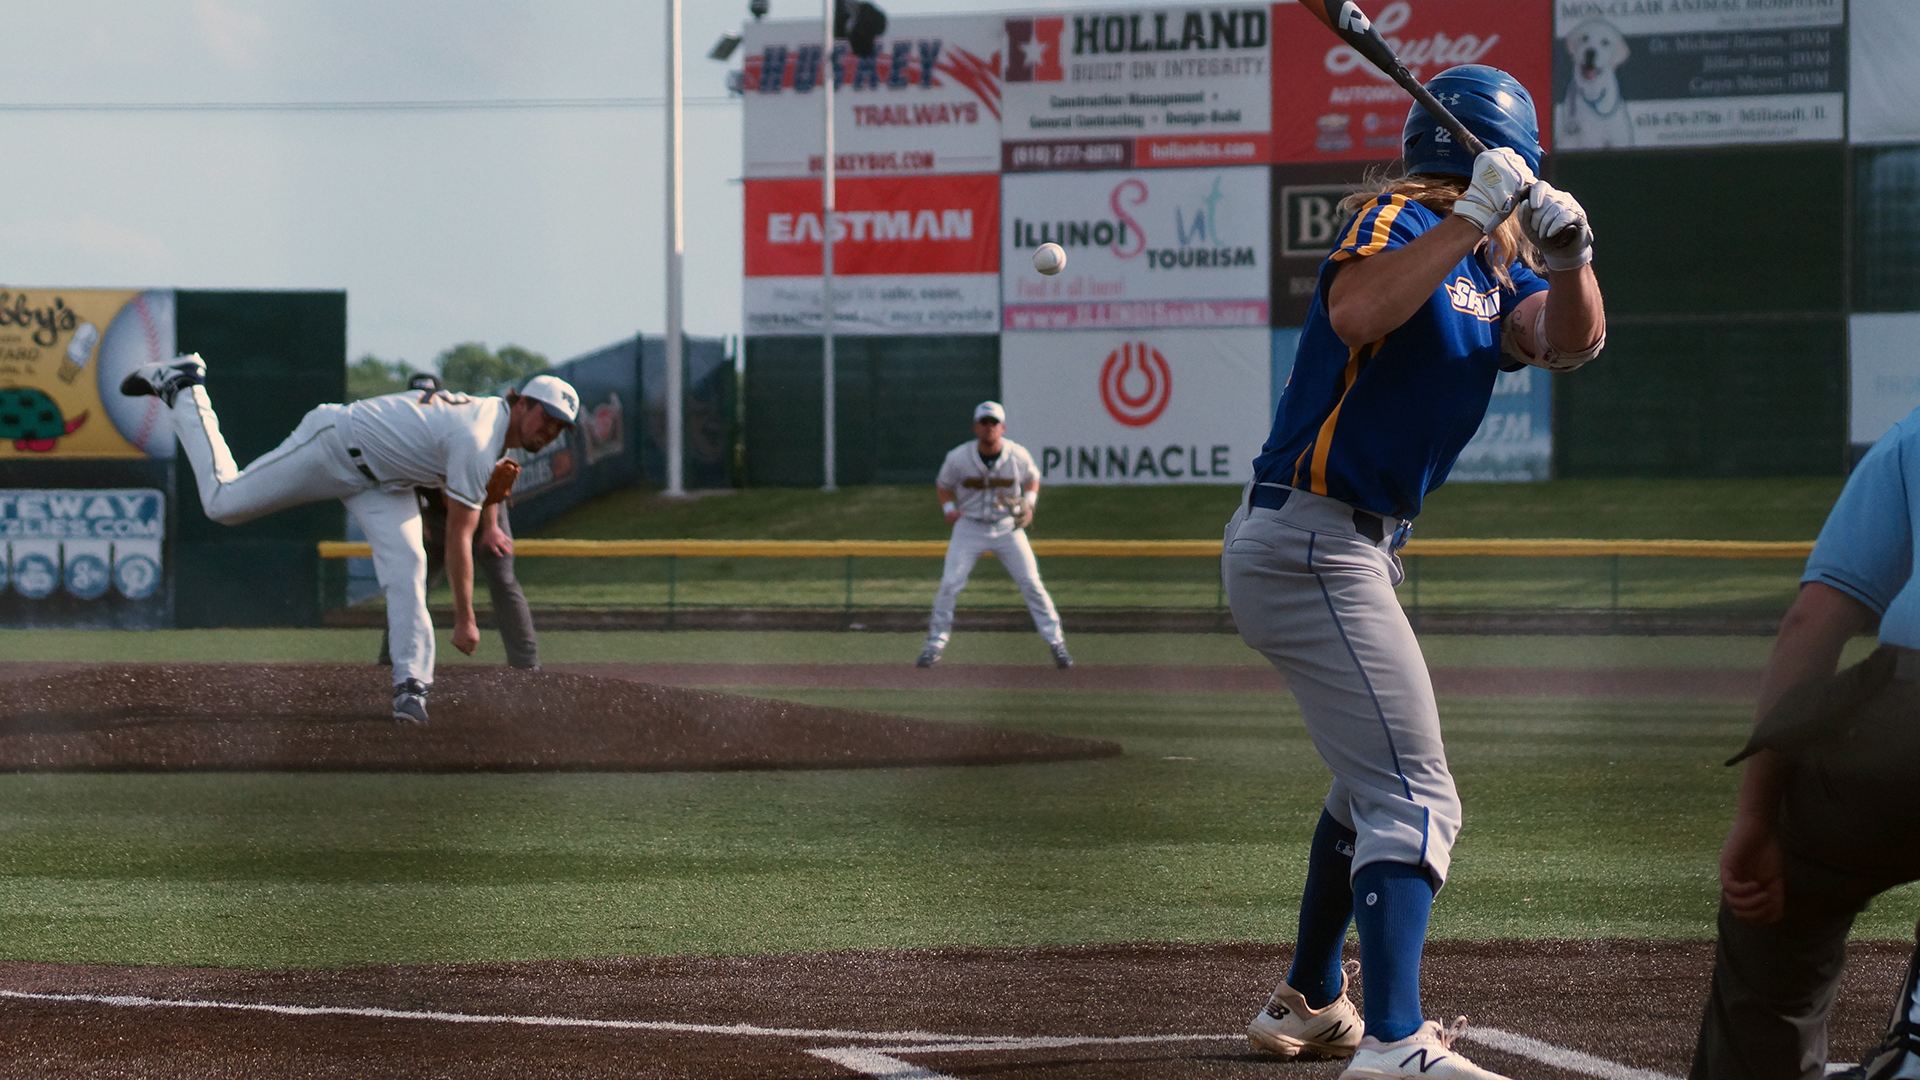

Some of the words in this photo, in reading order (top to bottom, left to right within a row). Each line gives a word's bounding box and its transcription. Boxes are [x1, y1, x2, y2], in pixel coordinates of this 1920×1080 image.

[1072, 10, 1267, 54] HOLLAND
[1130, 60, 1157, 80] ON
[1163, 56, 1265, 78] INTEGRITY
[854, 102, 978, 126] TRAILWAYS
[1435, 126, 1451, 143] 22
[767, 209, 974, 243] EASTMAN
[1146, 246, 1256, 269] TOURISM
[1041, 445, 1231, 479] PINNACLE
[0, 518, 162, 537] ZLIES.COM
